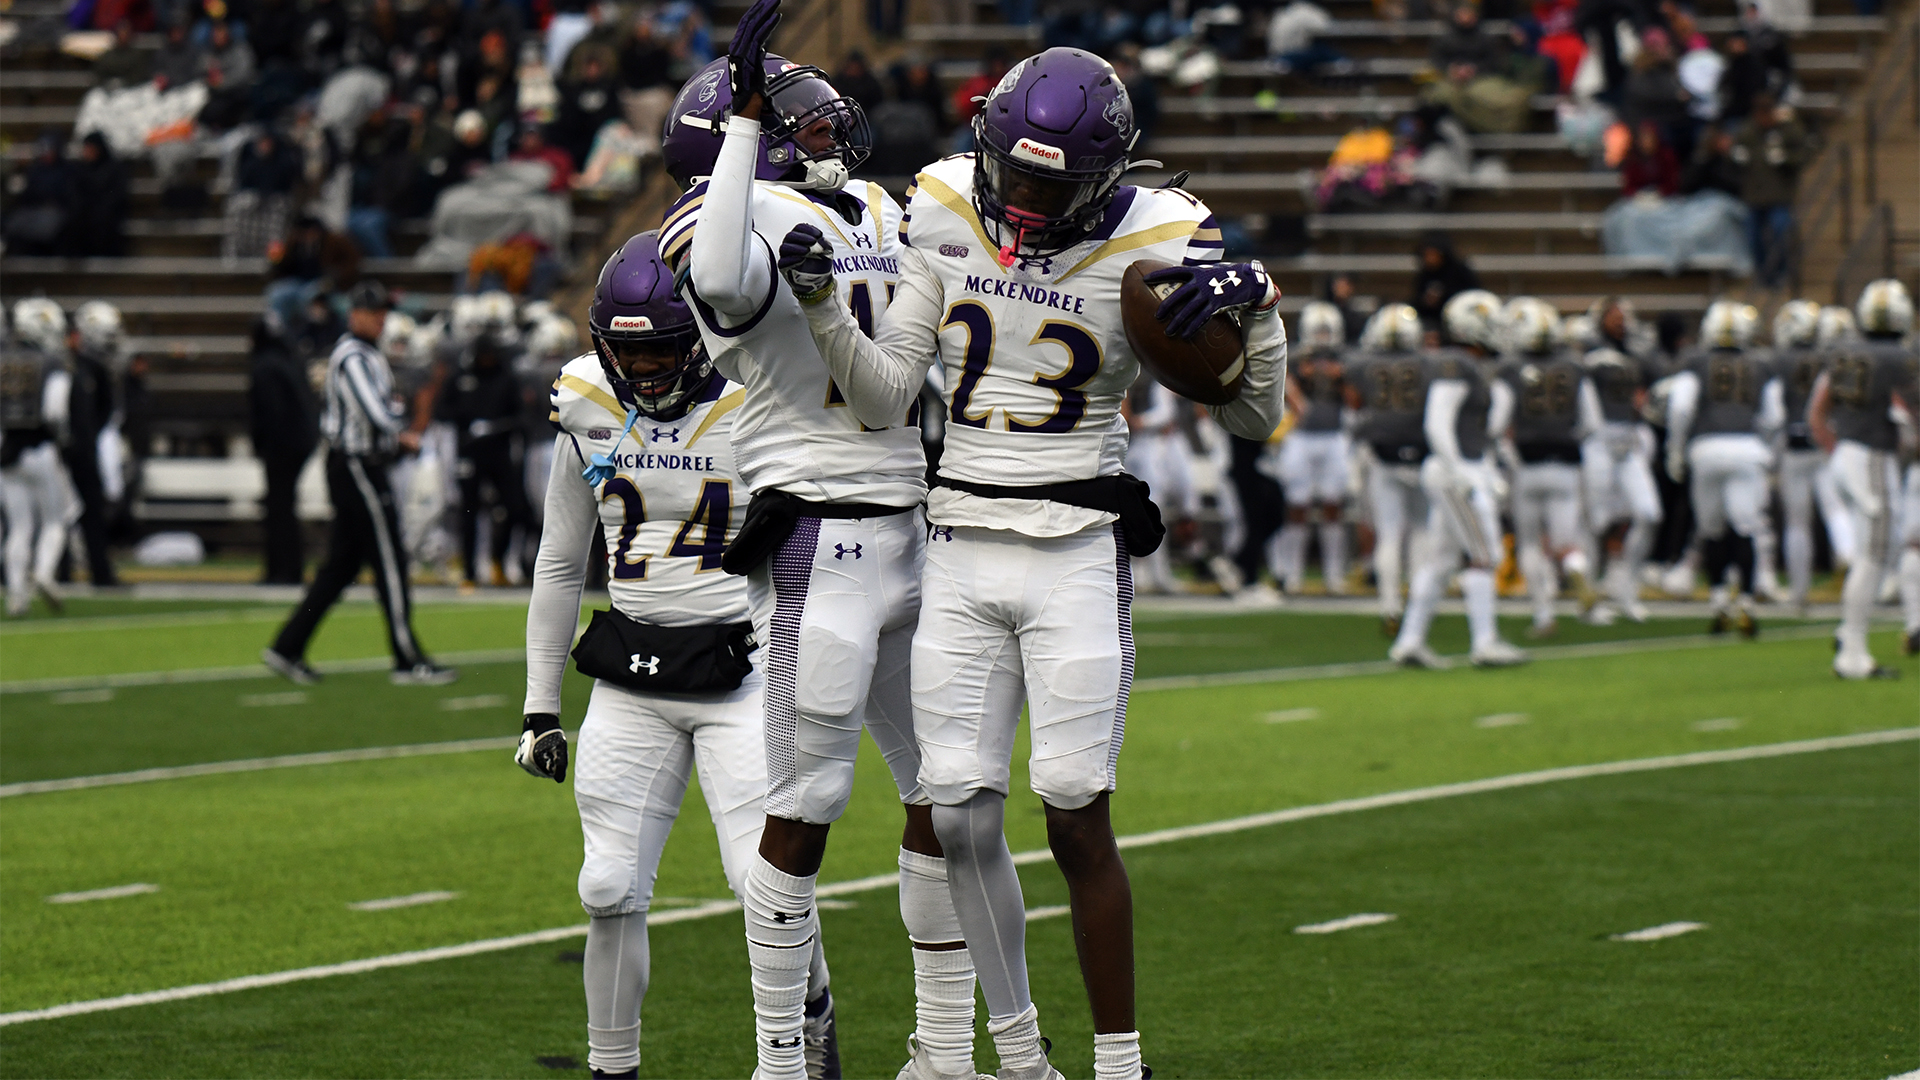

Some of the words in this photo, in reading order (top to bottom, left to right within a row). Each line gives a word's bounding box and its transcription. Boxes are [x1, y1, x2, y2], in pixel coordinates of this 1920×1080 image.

[1021, 142, 1060, 160] Riddell
[832, 254, 899, 275] MCKENDREE
[964, 275, 1085, 315] MCKENDREE
[938, 298, 1105, 433] 23
[612, 453, 715, 471] MCKENDREE
[601, 474, 733, 582] 24
